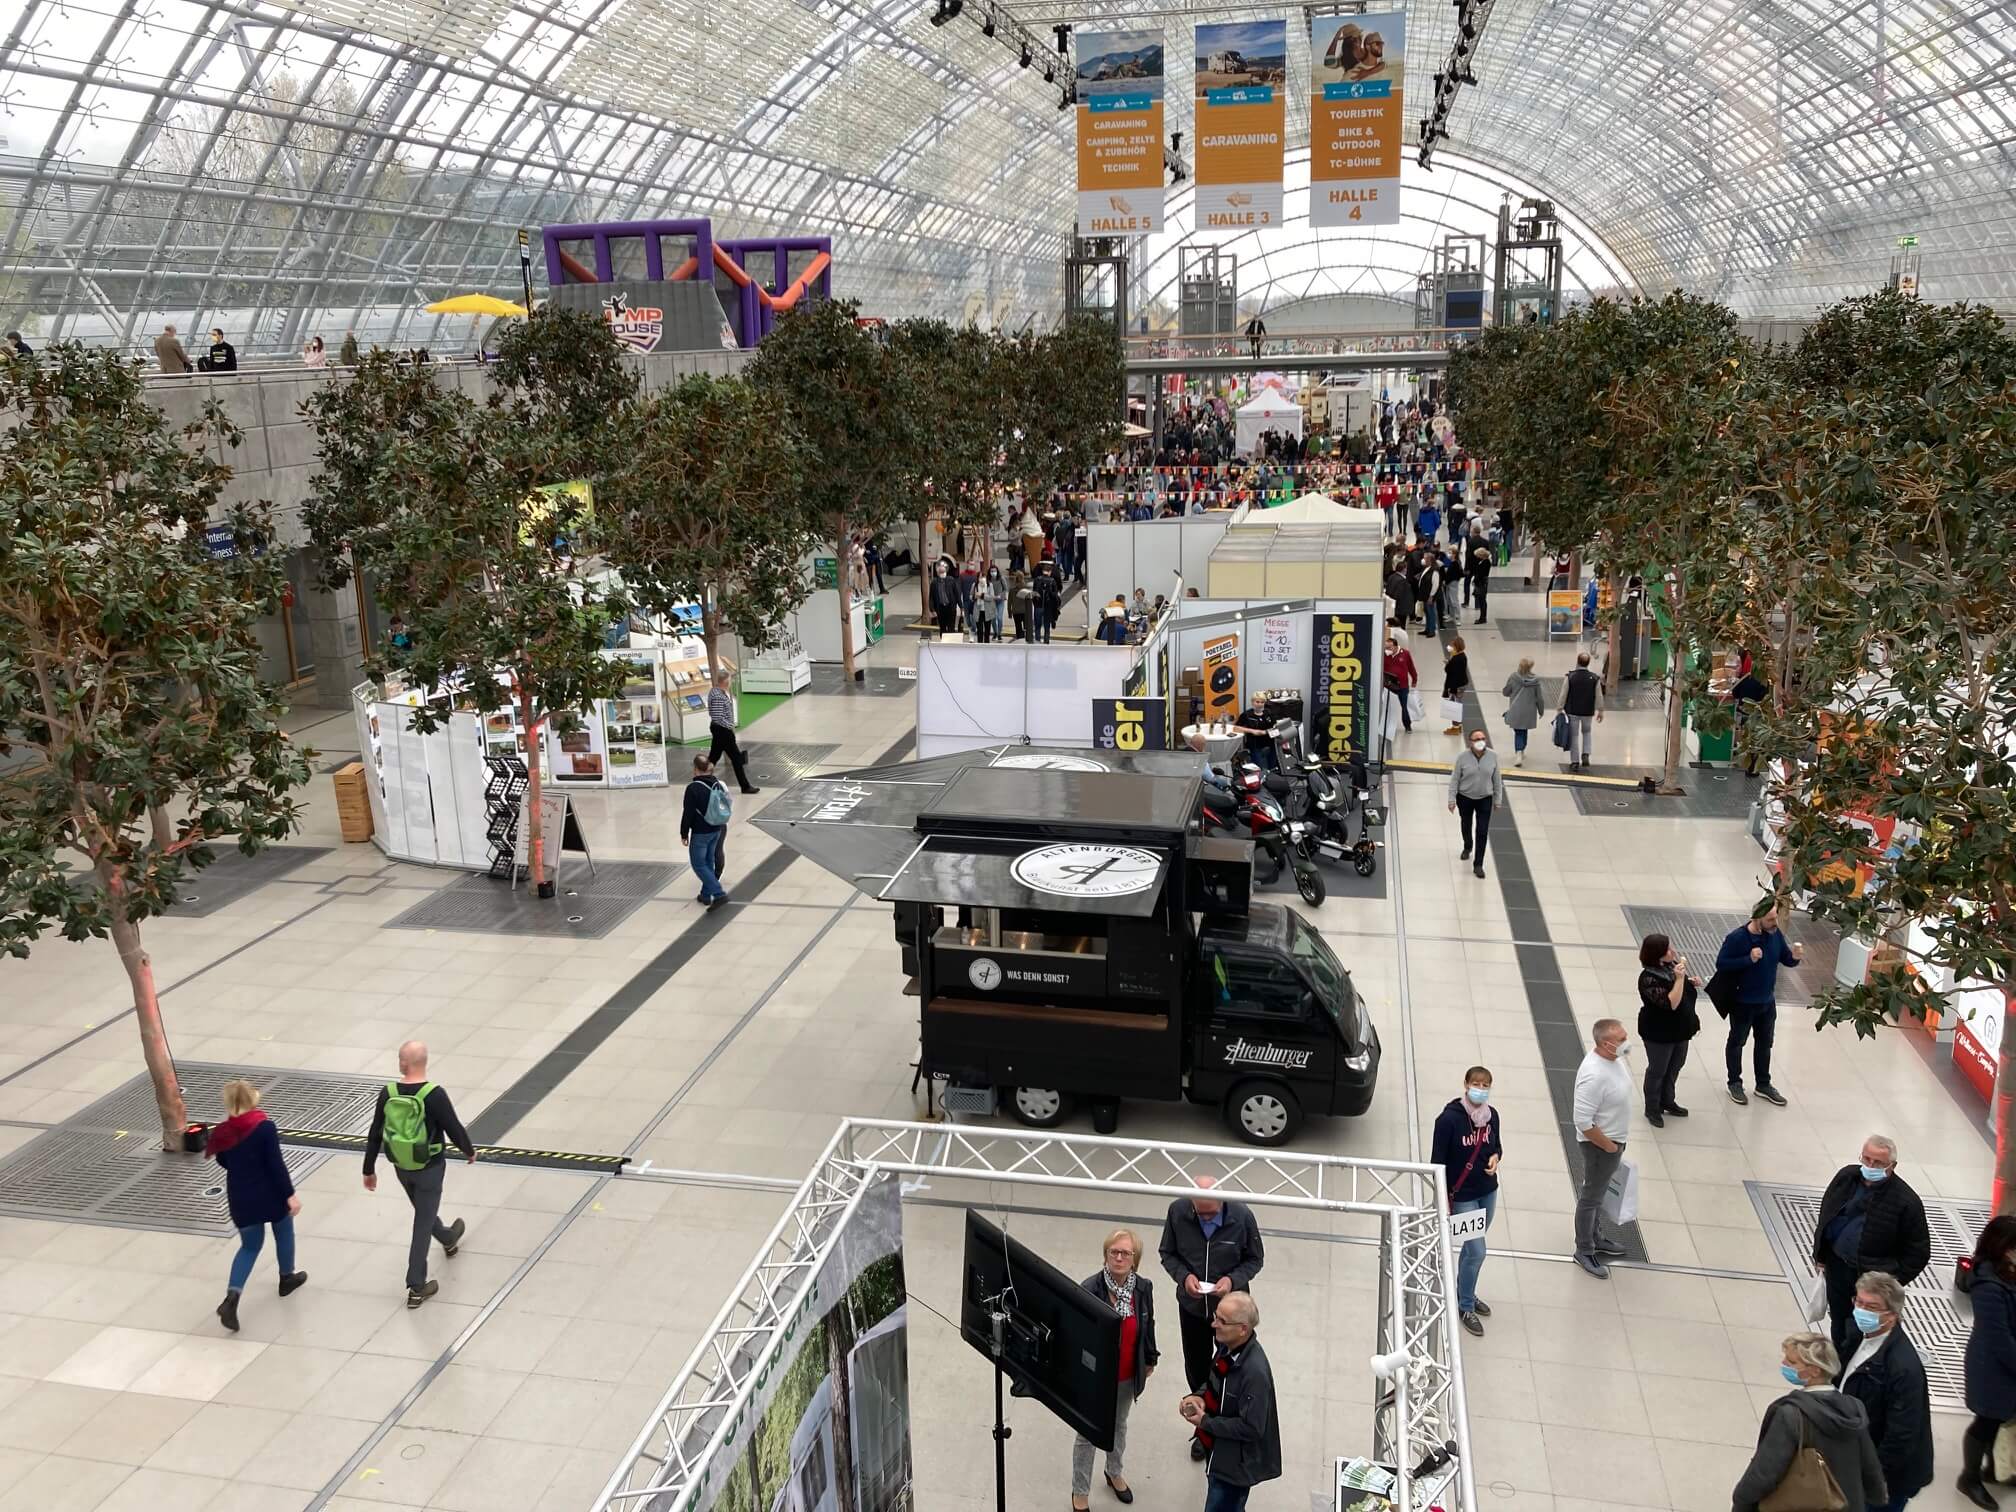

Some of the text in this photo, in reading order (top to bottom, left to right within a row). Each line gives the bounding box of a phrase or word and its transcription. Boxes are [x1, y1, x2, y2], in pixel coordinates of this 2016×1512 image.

[1330, 108, 1384, 120] TOURISTIK
[1094, 120, 1147, 129] CARAVANING
[1338, 127, 1374, 137] BIKE &
[1130, 135, 1155, 144] ZELTE
[1202, 133, 1277, 147] CARAVANING
[1331, 140, 1381, 150] OUTDOOR
[1096, 146, 1146, 157] & ZUBEHÖR
[1102, 163, 1139, 172] TECHNIK
[1330, 156, 1382, 168] TC-BÜHNE
[1329, 189, 1378, 203] HALLE
[1208, 211, 1270, 225] HALLE 3
[1349, 205, 1362, 221] 4
[1091, 217, 1151, 231] HALLE 5
[612, 323, 660, 334] OUSE
[1316, 635, 1330, 703] shops.de
[1115, 701, 1144, 750] er
[1100, 725, 1114, 748] de
[1040, 846, 1151, 865] ALTENBURGER
[1006, 970, 1022, 980] WAS
[1023, 972, 1041, 982] DENN
[1224, 1037, 1314, 1069] Altenburger
[1450, 1217, 1485, 1236] LA13
